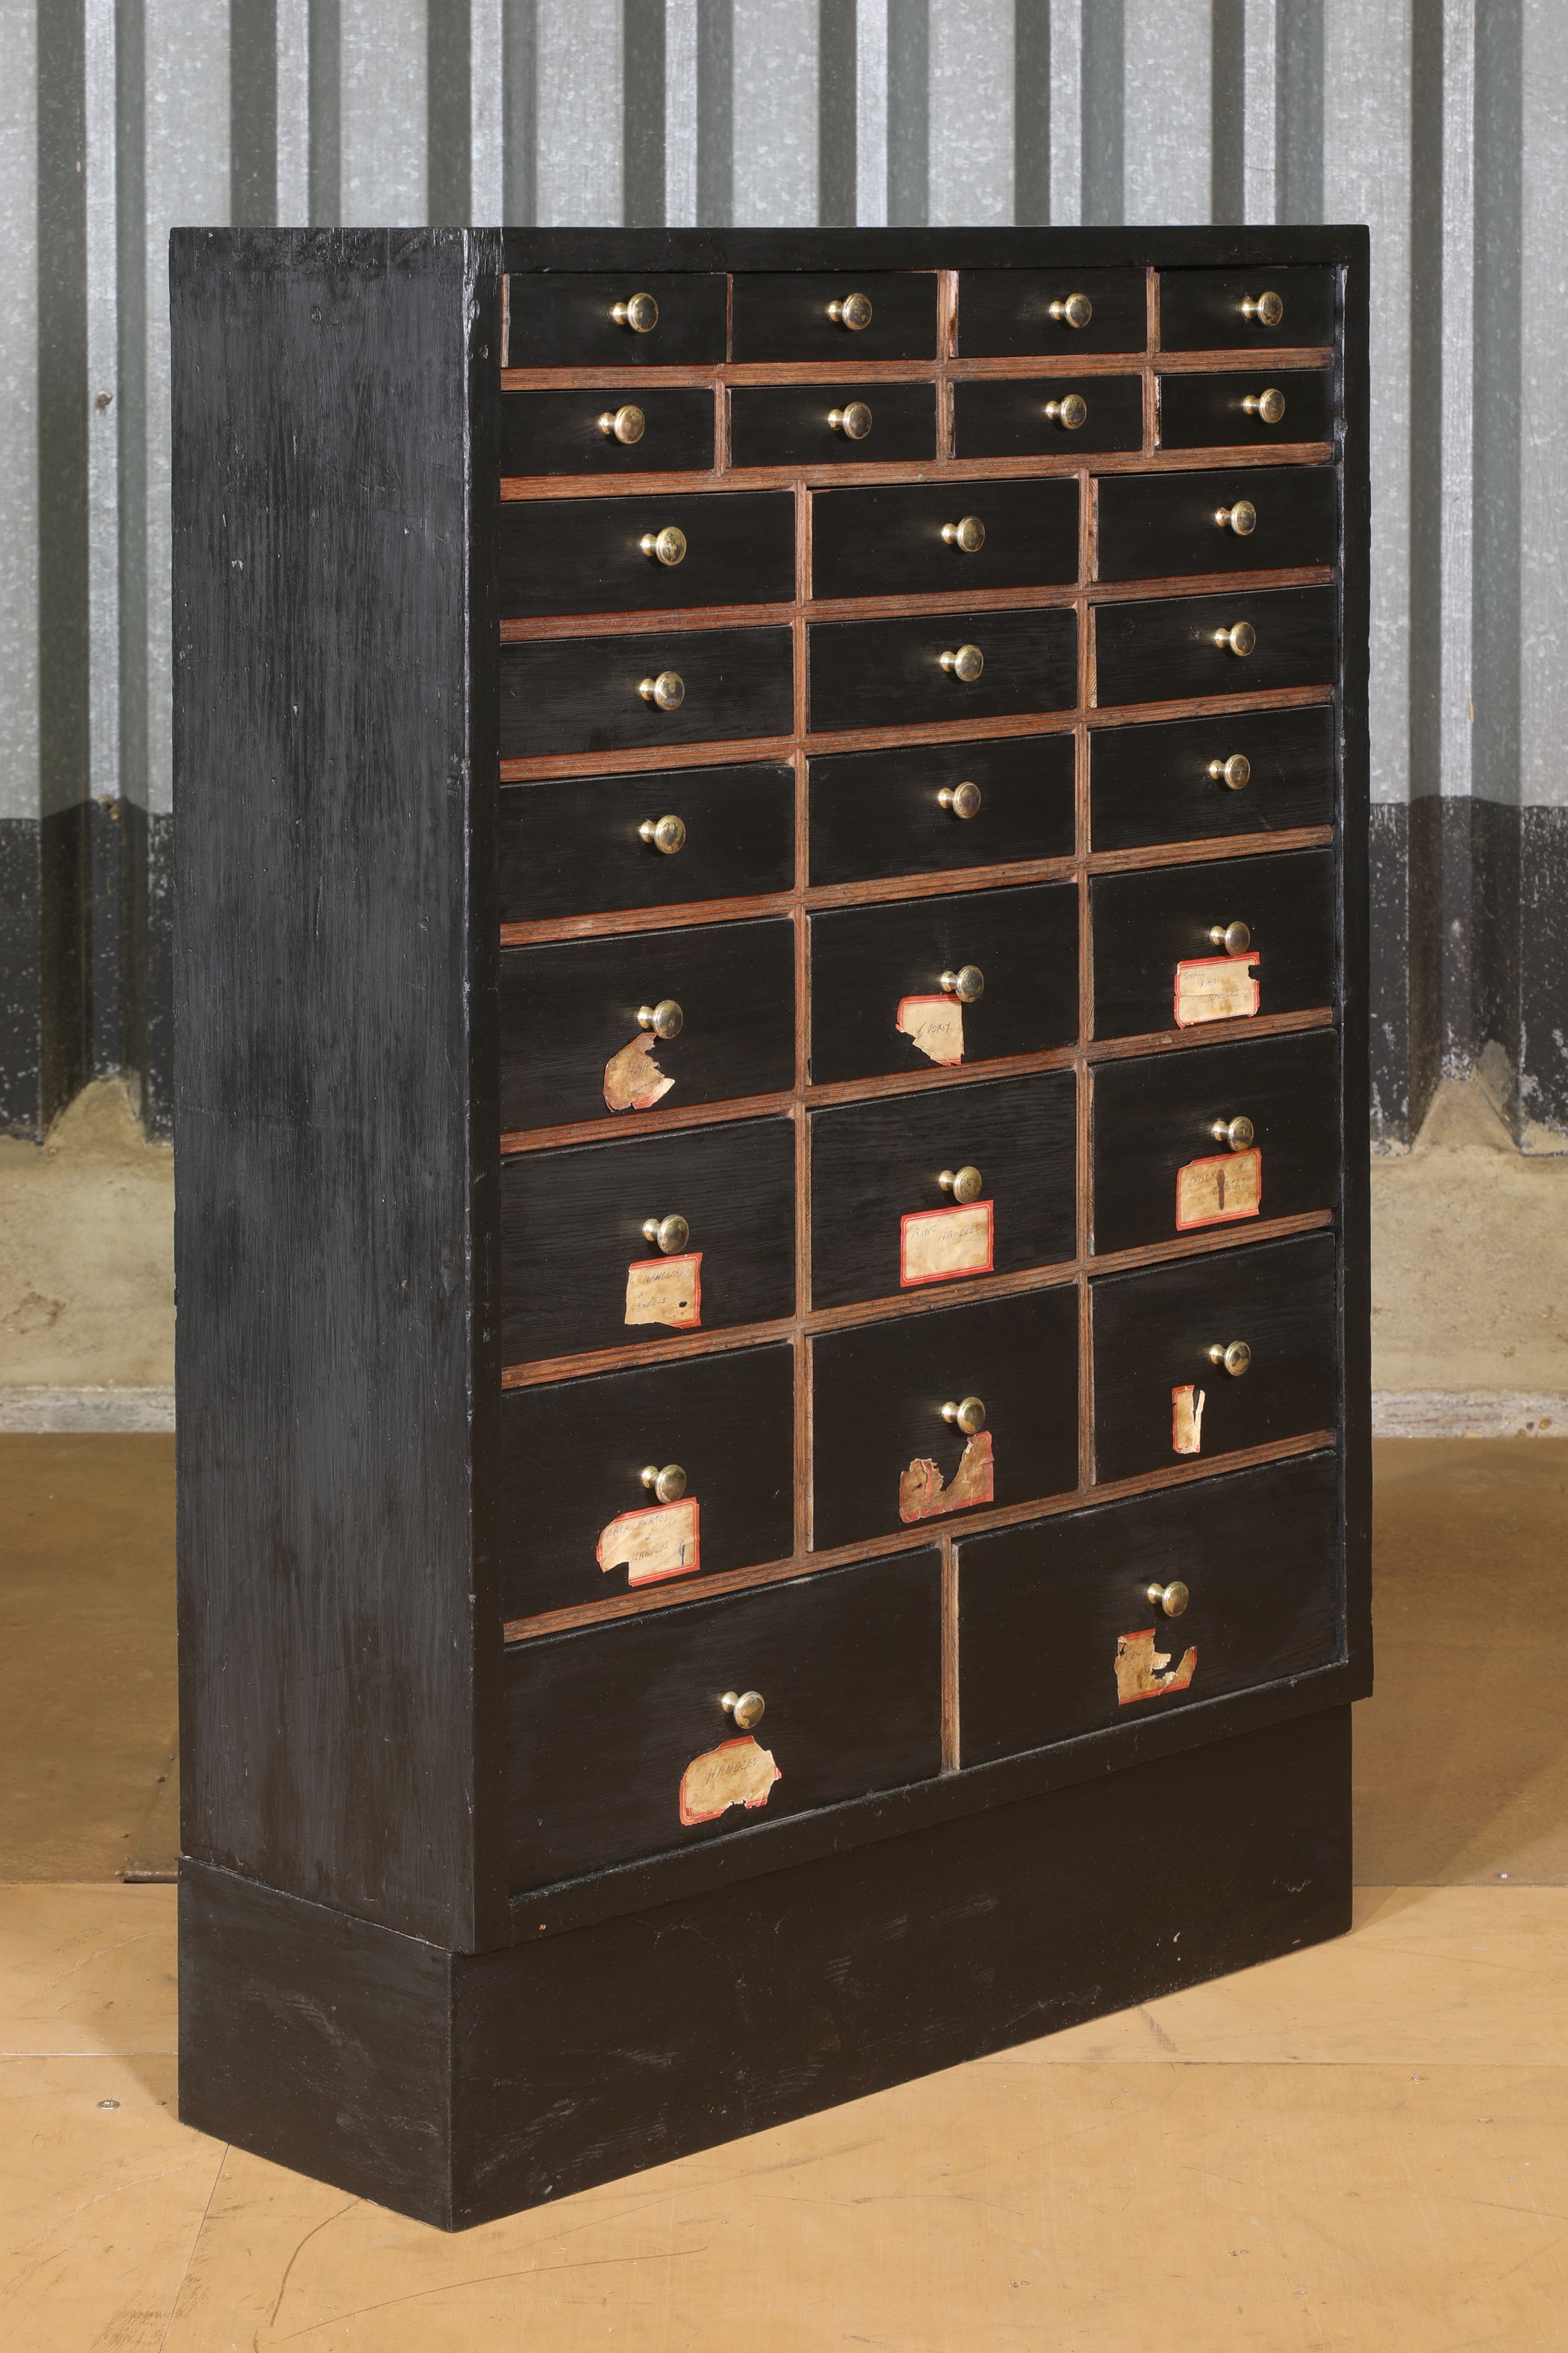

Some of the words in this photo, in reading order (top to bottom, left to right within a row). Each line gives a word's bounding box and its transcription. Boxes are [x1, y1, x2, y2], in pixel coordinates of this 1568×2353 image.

[911, 1224, 936, 1241] RING
[938, 1224, 979, 1242] HANDLES
[629, 1298, 667, 1313] HANDLES
[606, 1523, 631, 1539] BACK
[638, 1513, 669, 1528] PLATES
[1123, 1650, 1143, 1667] KEY
